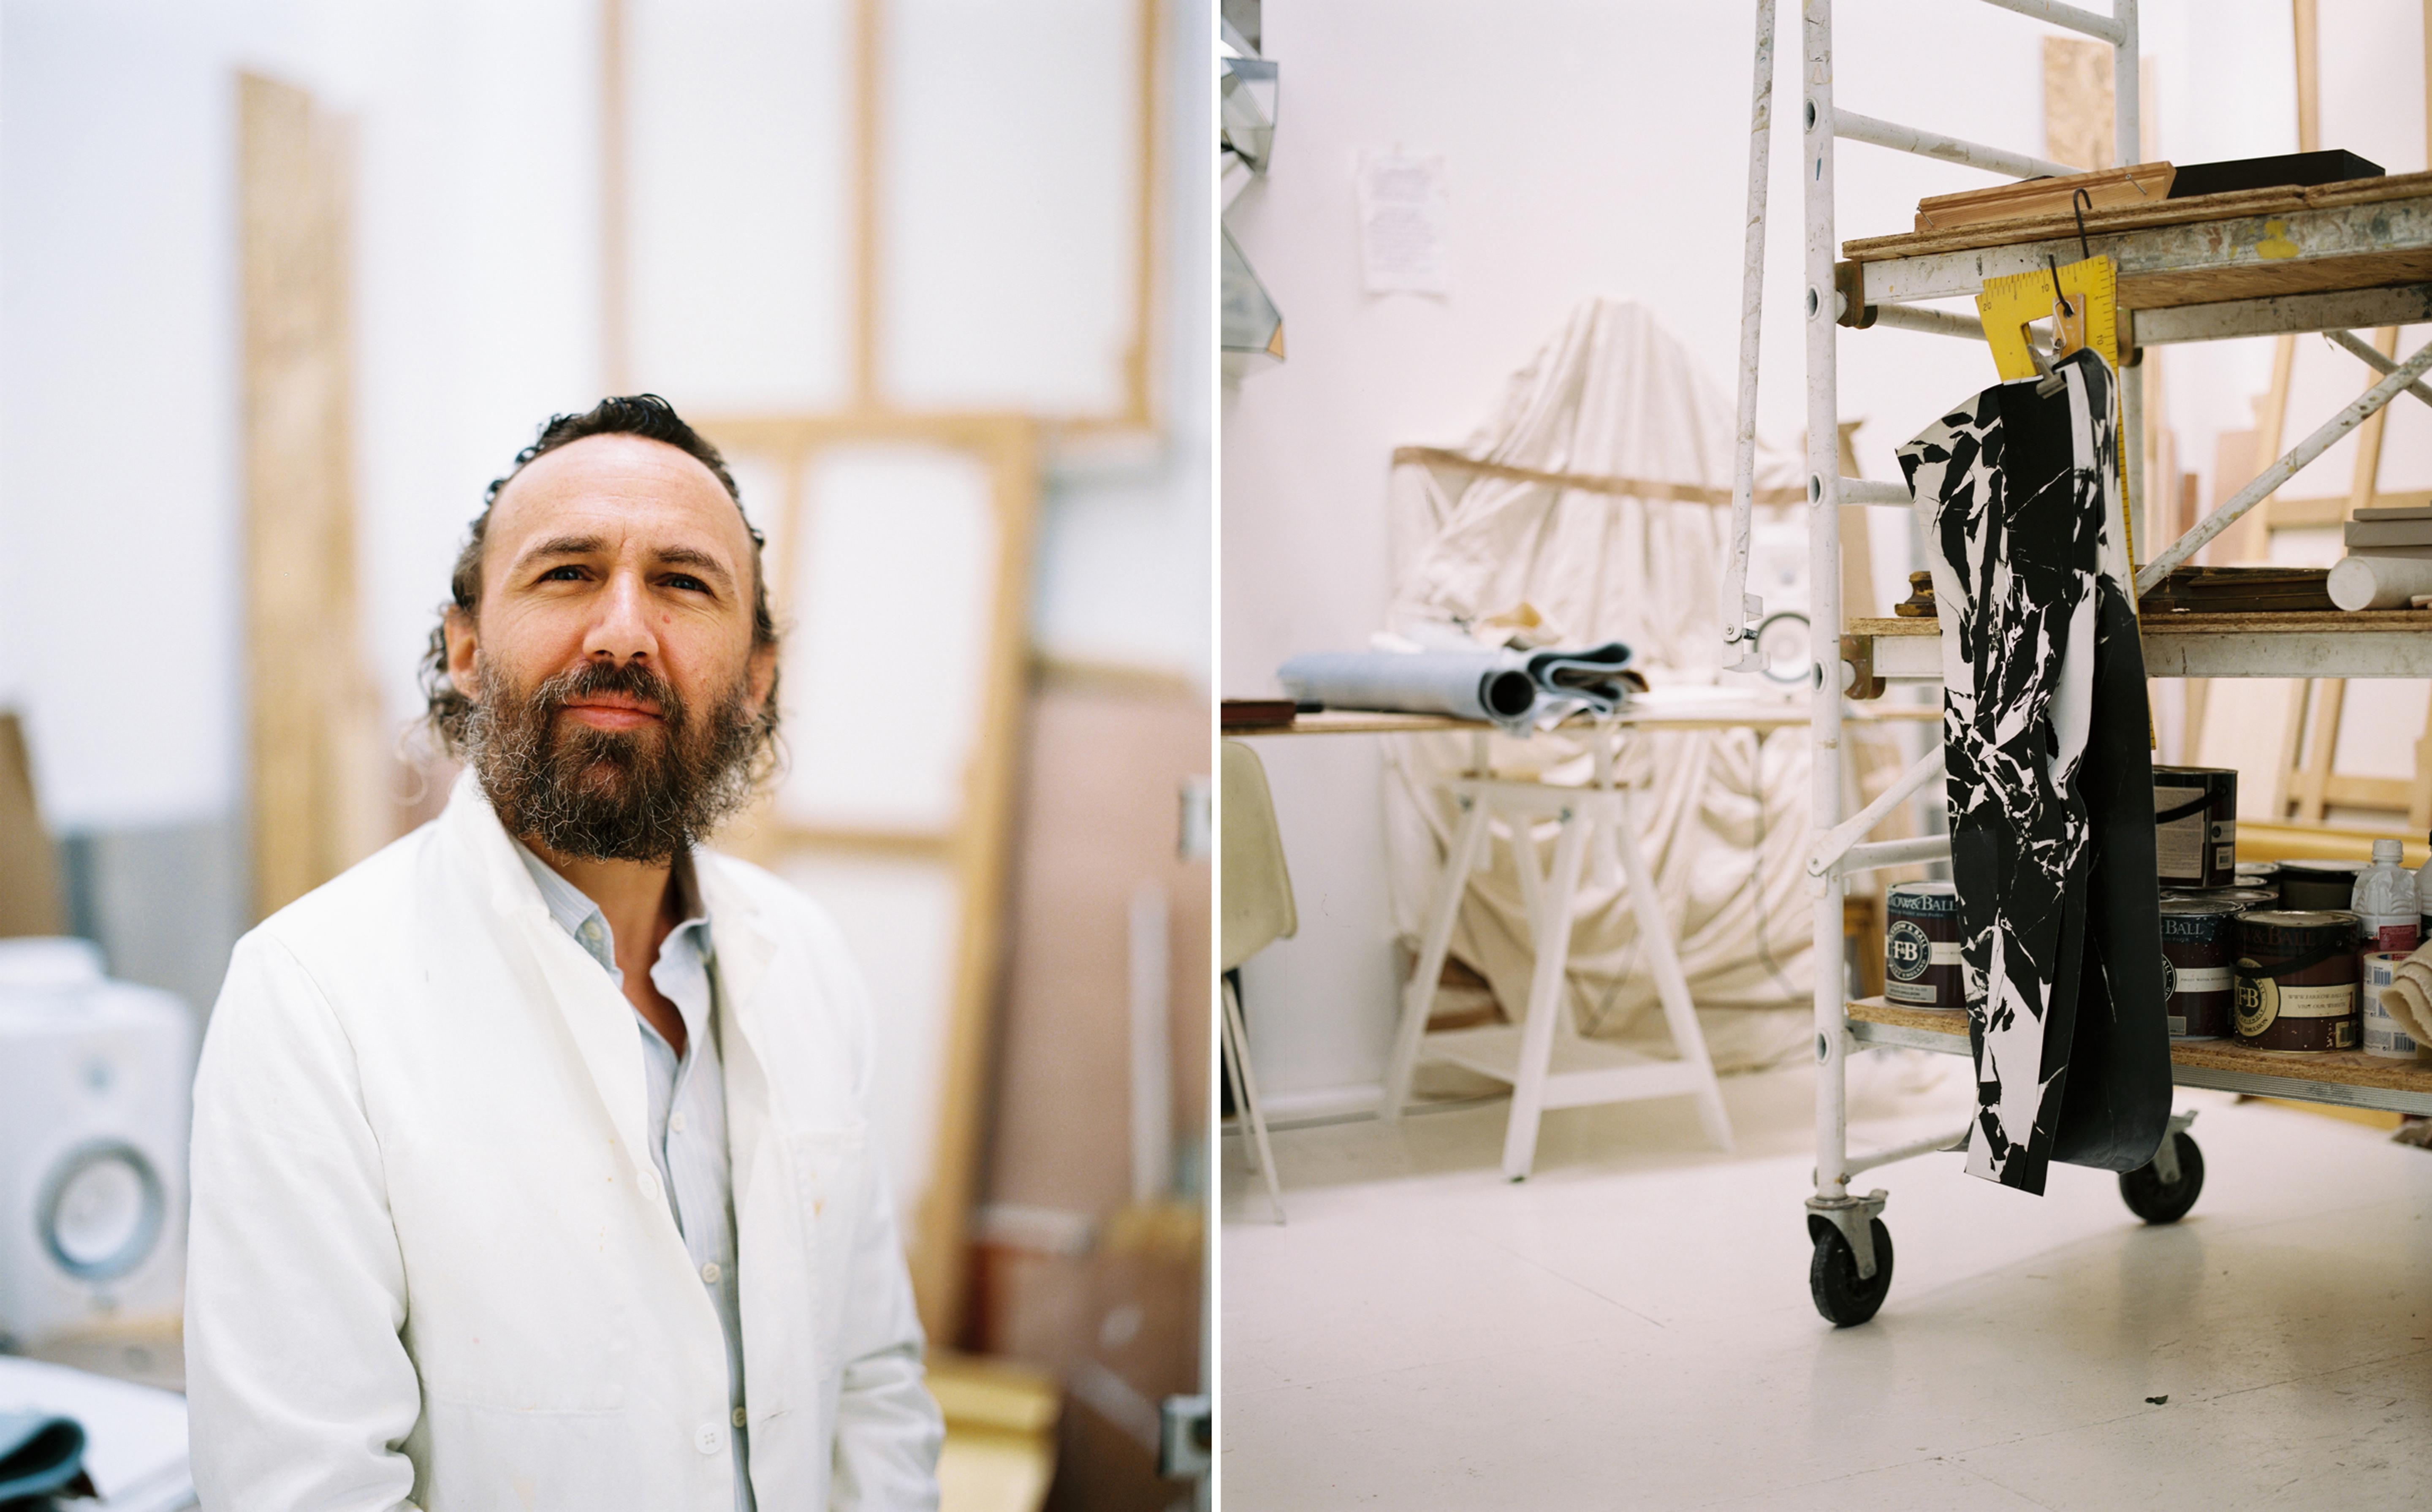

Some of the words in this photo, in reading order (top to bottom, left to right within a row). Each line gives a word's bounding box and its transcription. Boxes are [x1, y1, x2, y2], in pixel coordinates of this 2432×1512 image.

[2041, 284, 2049, 293] 10
[1983, 302, 1992, 311] 20
[2097, 334, 2104, 345] 10
